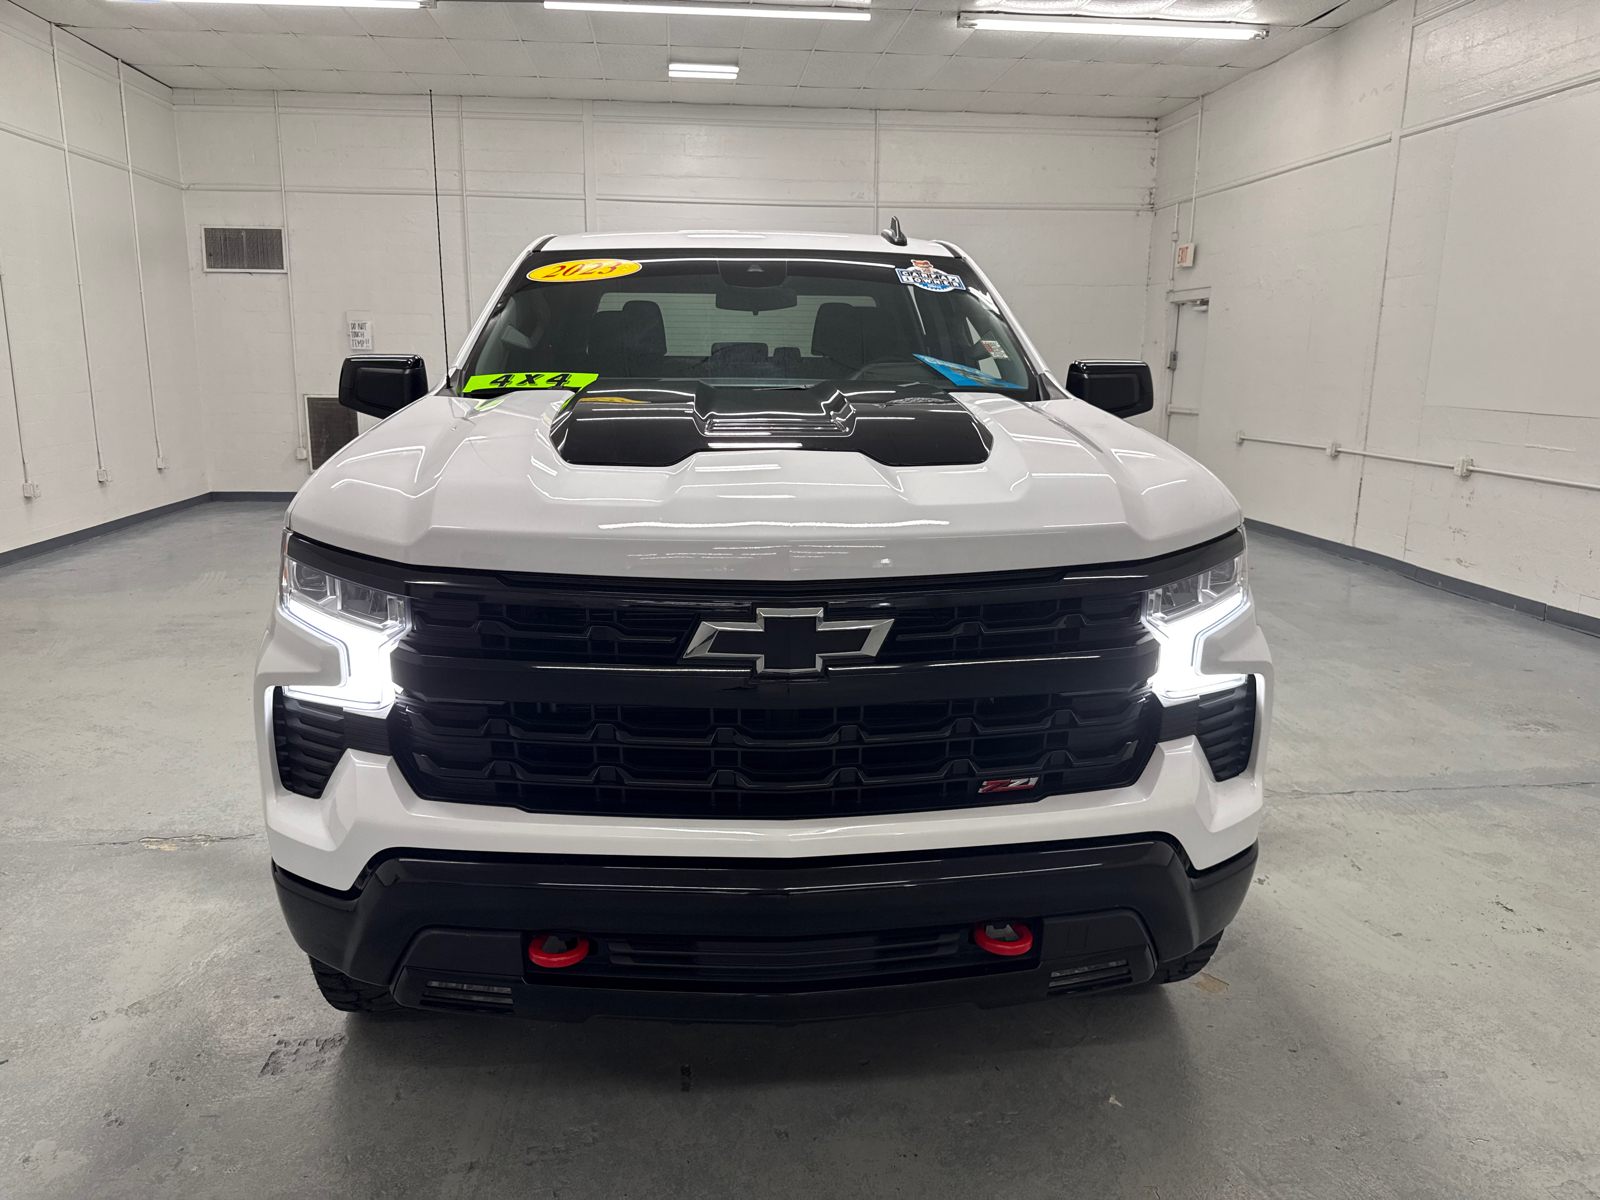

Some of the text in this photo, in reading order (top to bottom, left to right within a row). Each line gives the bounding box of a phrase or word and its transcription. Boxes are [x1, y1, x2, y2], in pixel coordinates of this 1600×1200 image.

[1177, 246, 1189, 264] EXIT
[541, 262, 622, 278] 2023
[350, 322, 367, 331] DO NOT
[350, 330, 365, 339] TOUCH
[978, 777, 1039, 793] Z71
